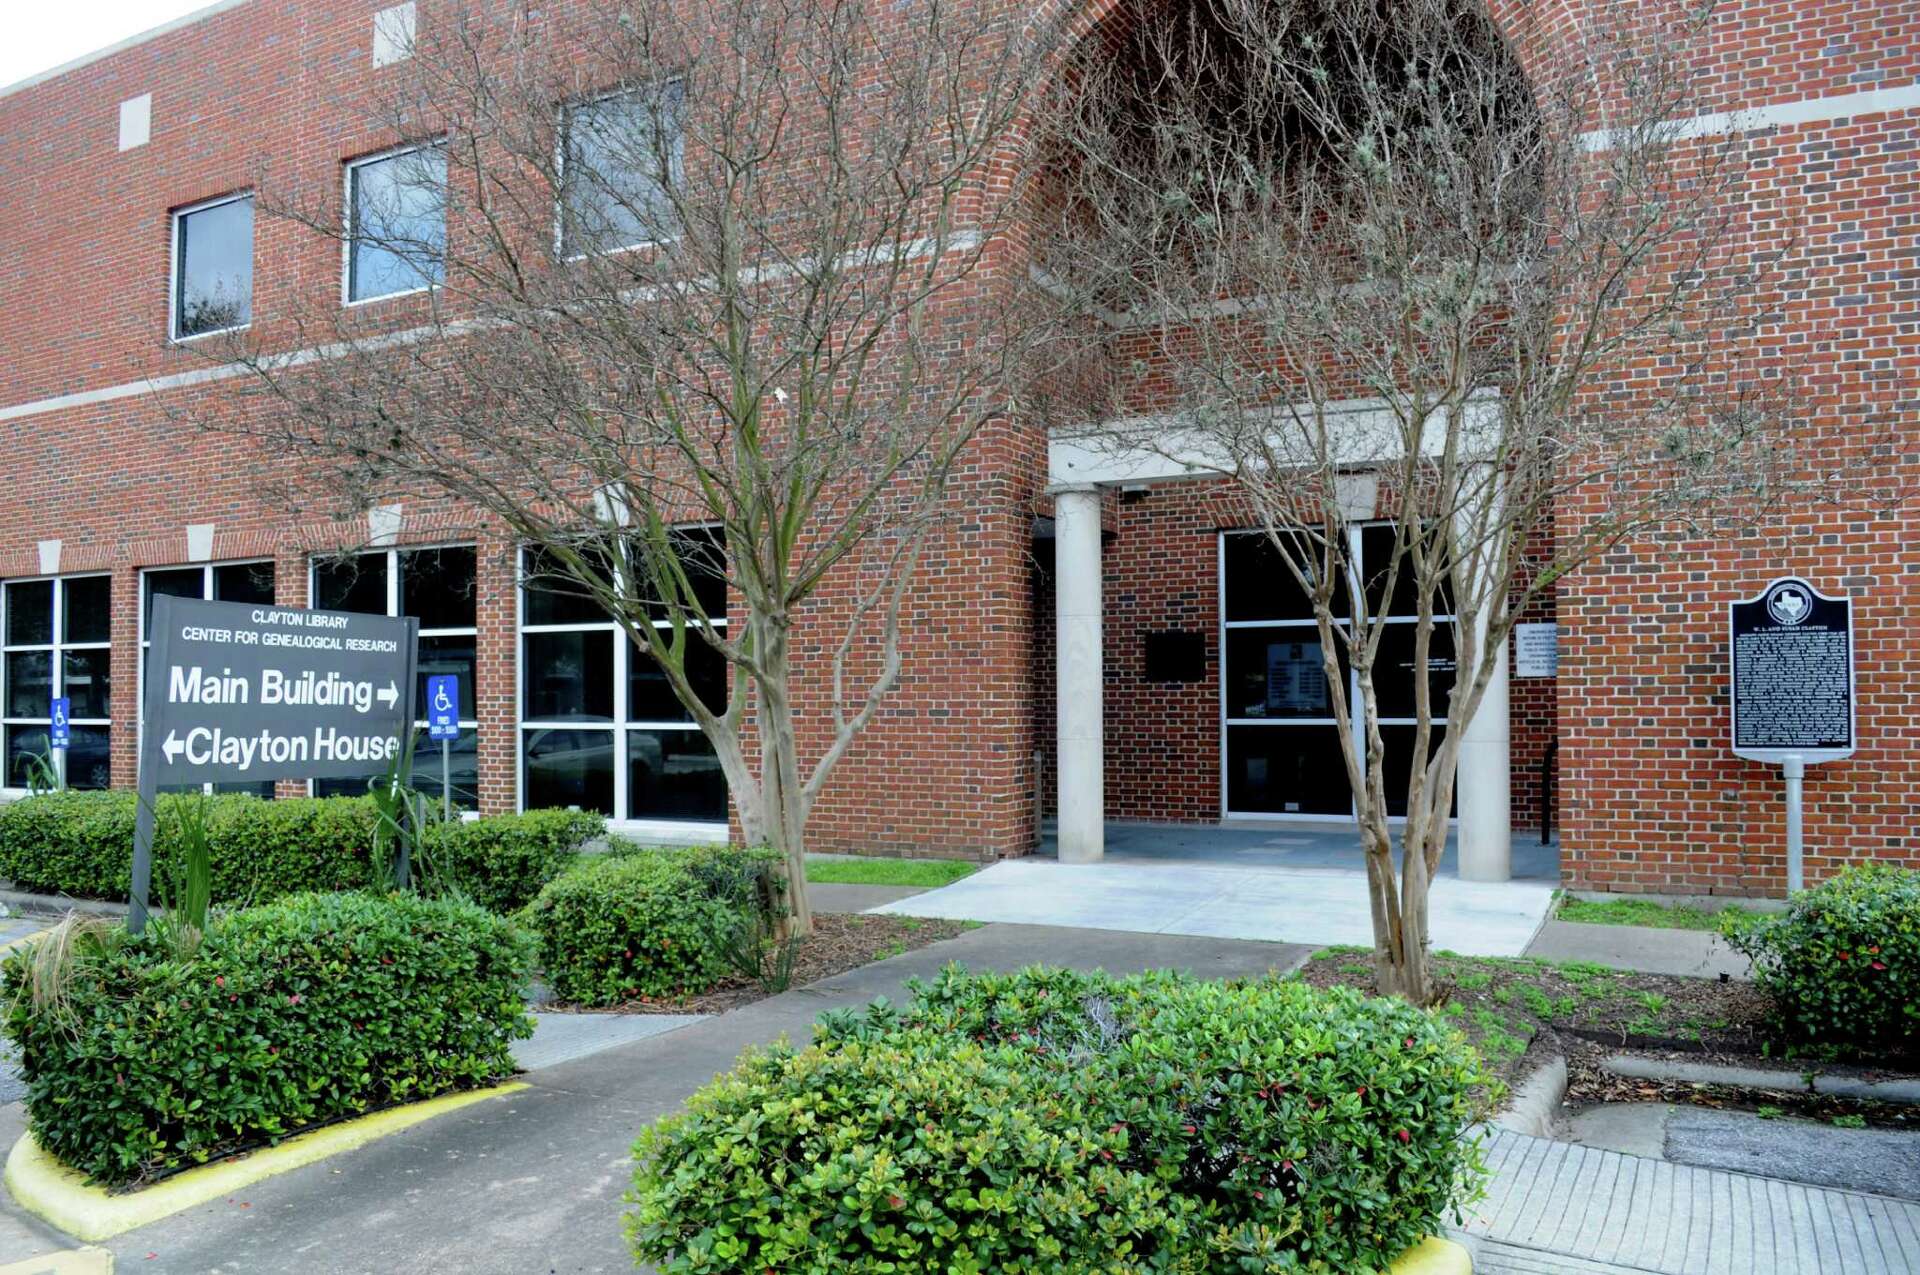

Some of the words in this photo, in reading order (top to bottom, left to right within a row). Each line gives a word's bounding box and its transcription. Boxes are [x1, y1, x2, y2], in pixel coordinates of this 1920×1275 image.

[252, 610, 303, 626] CLAYTON
[306, 614, 349, 629] LIBRARY
[182, 626, 232, 643] CENTER
[234, 630, 259, 645] FOR
[262, 632, 343, 650] GENEALOGICAL
[345, 638, 397, 653] RESEARCH
[168, 665, 249, 705] Main
[260, 669, 373, 713] Building
[185, 727, 308, 770] Clayton
[313, 727, 400, 761] House
